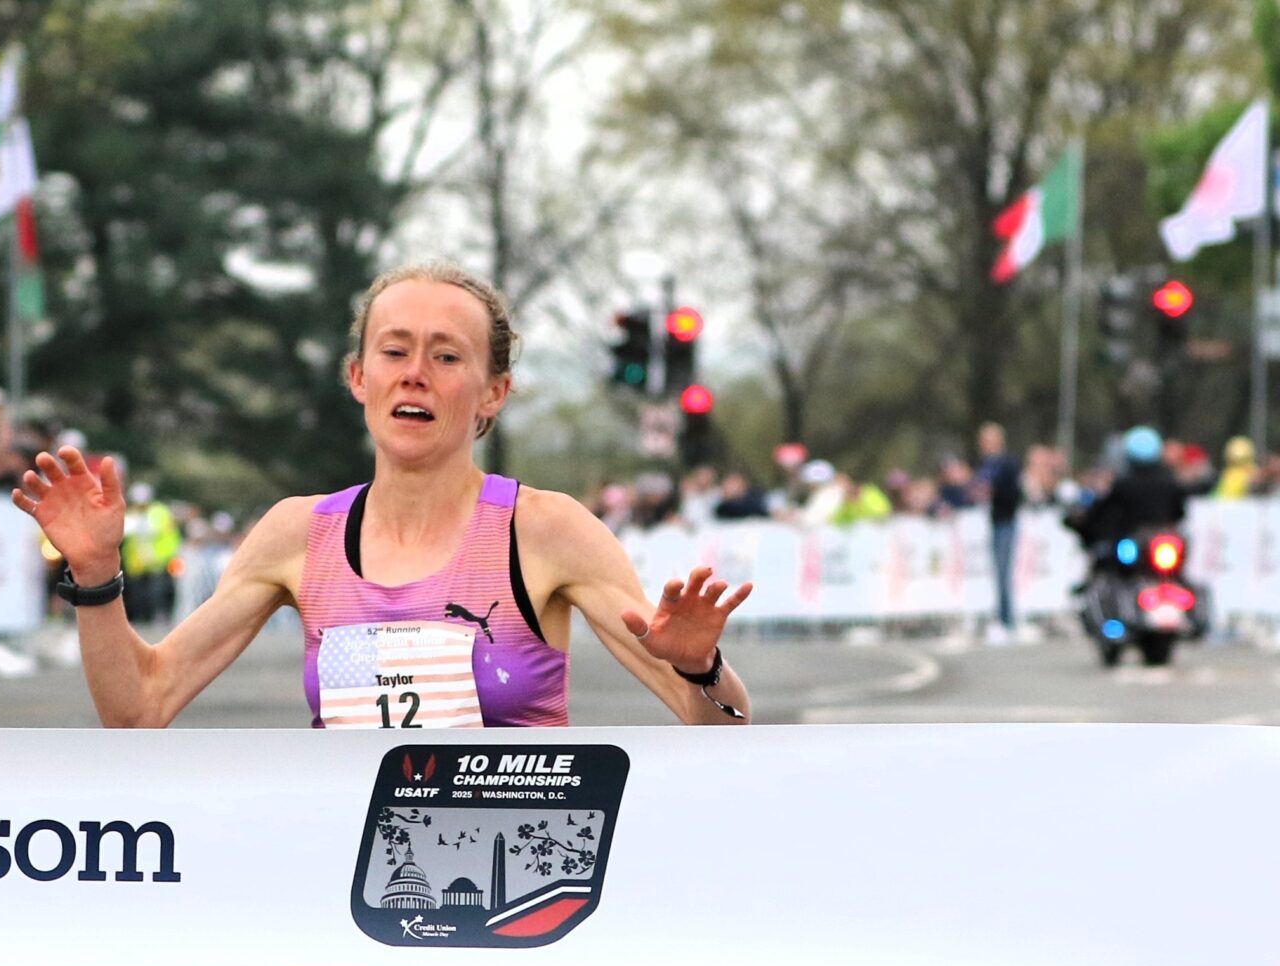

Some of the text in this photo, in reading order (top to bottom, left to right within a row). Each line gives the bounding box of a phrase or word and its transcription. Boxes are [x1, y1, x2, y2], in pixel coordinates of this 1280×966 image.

[385, 626, 421, 634] Running
[375, 673, 414, 688] Taylor
[376, 691, 423, 728] 12
[457, 754, 575, 774] 10 MILE
[452, 774, 582, 787] CHAMPIONSHIPS
[394, 787, 440, 798] USATF
[451, 790, 567, 801] 2025 WASHINGTON, D.C.
[413, 924, 457, 932] Credit Union
